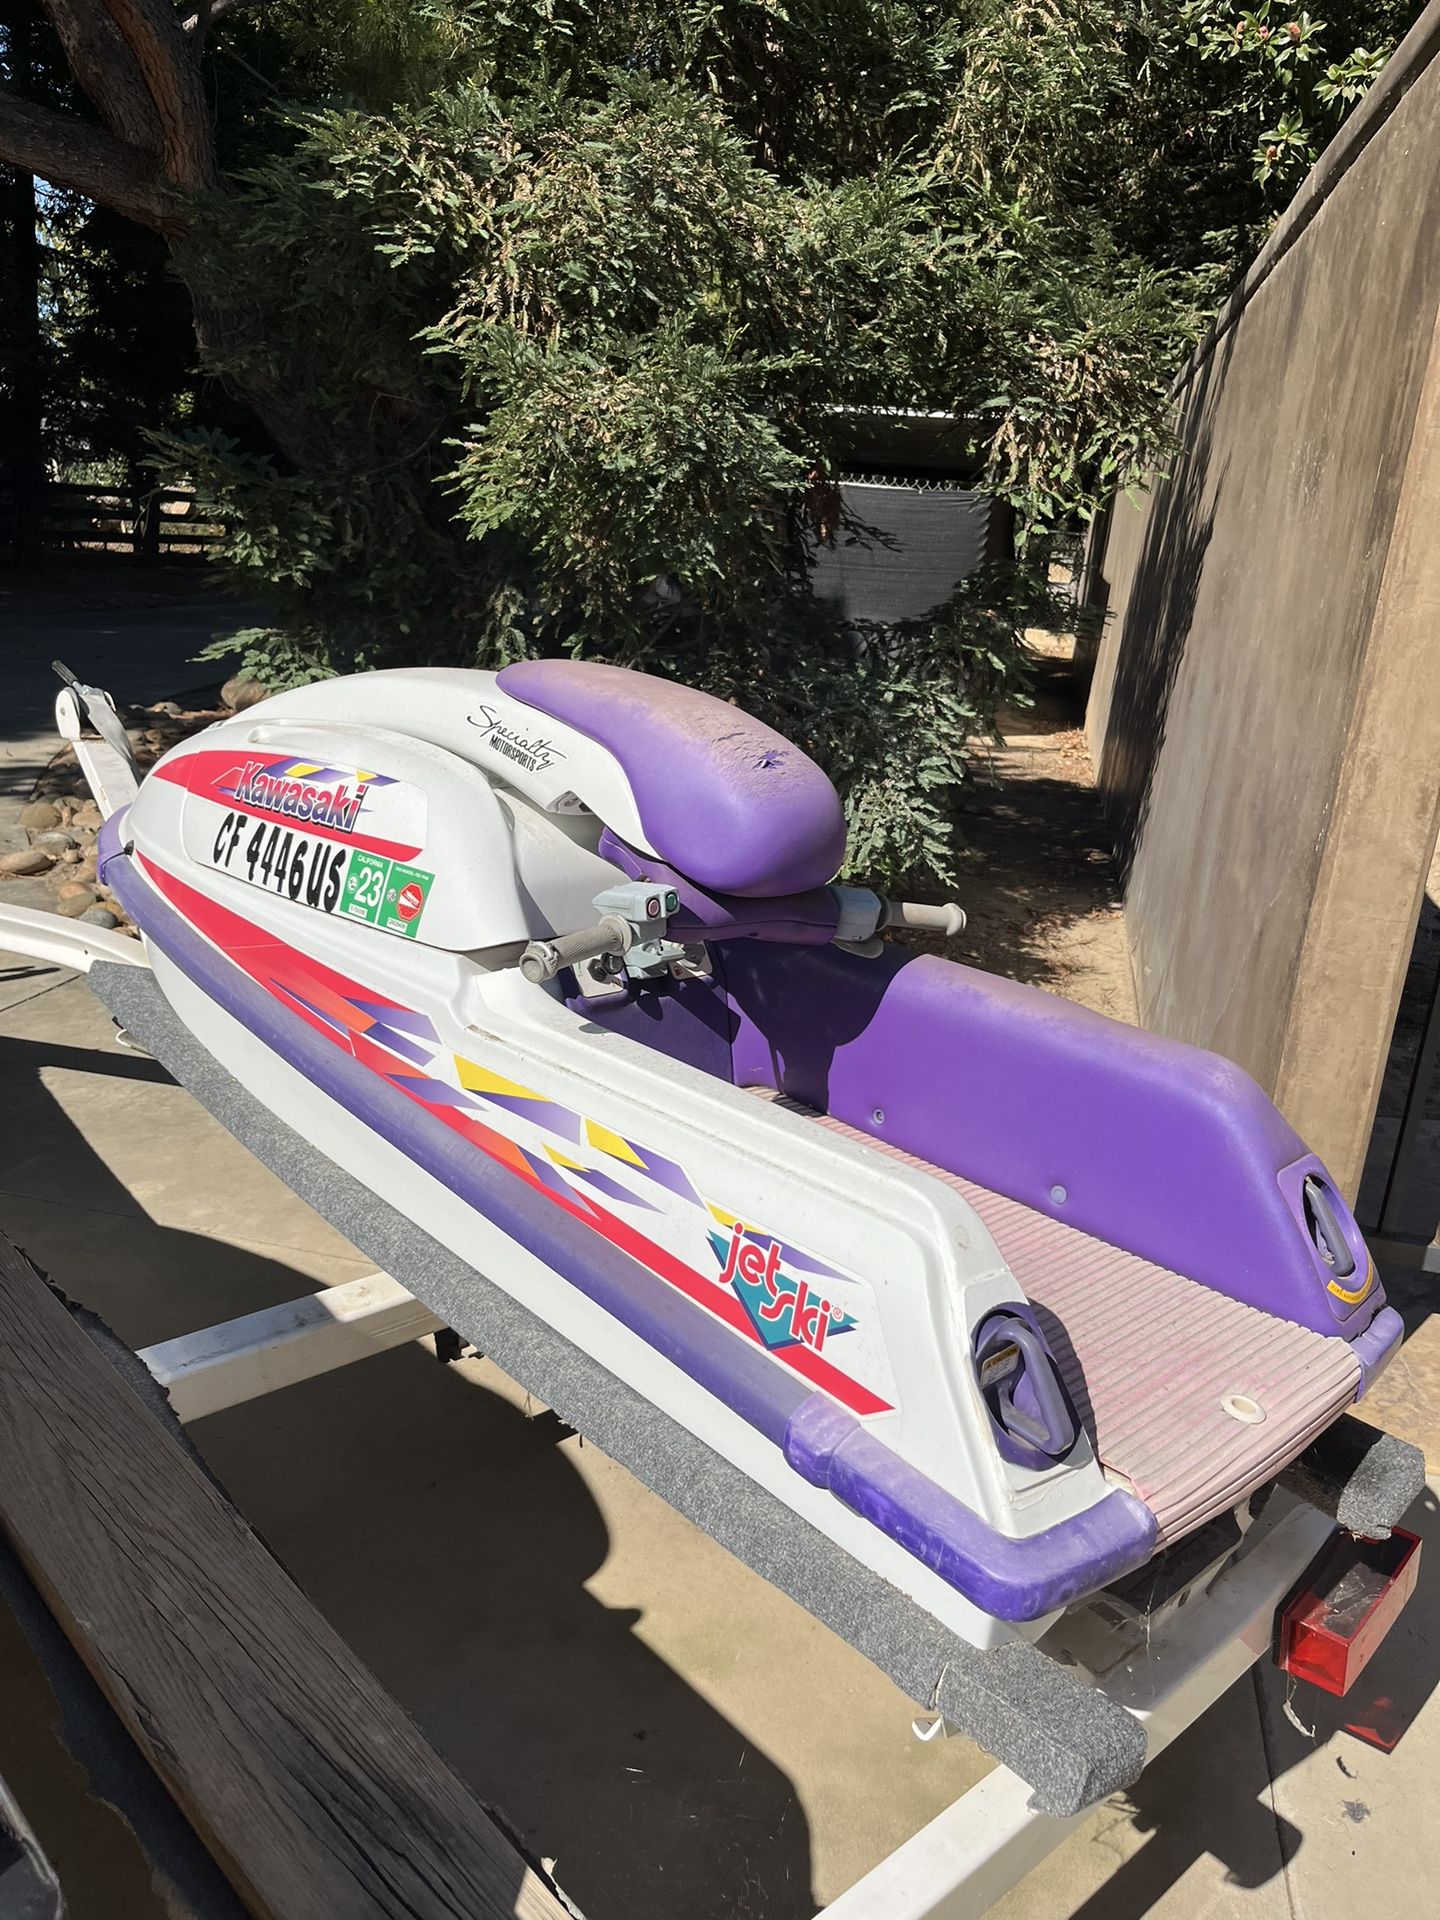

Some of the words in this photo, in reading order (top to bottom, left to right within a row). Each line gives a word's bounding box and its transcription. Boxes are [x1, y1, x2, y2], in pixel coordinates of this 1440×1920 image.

[466, 704, 568, 771] Specialty
[489, 733, 538, 772] MOTORSPORTS
[233, 760, 368, 834] Kawasaki
[213, 812, 248, 868] CF
[357, 854, 384, 869] CALIFORNIA
[353, 866, 385, 908] 23
[718, 1222, 782, 1298] jet
